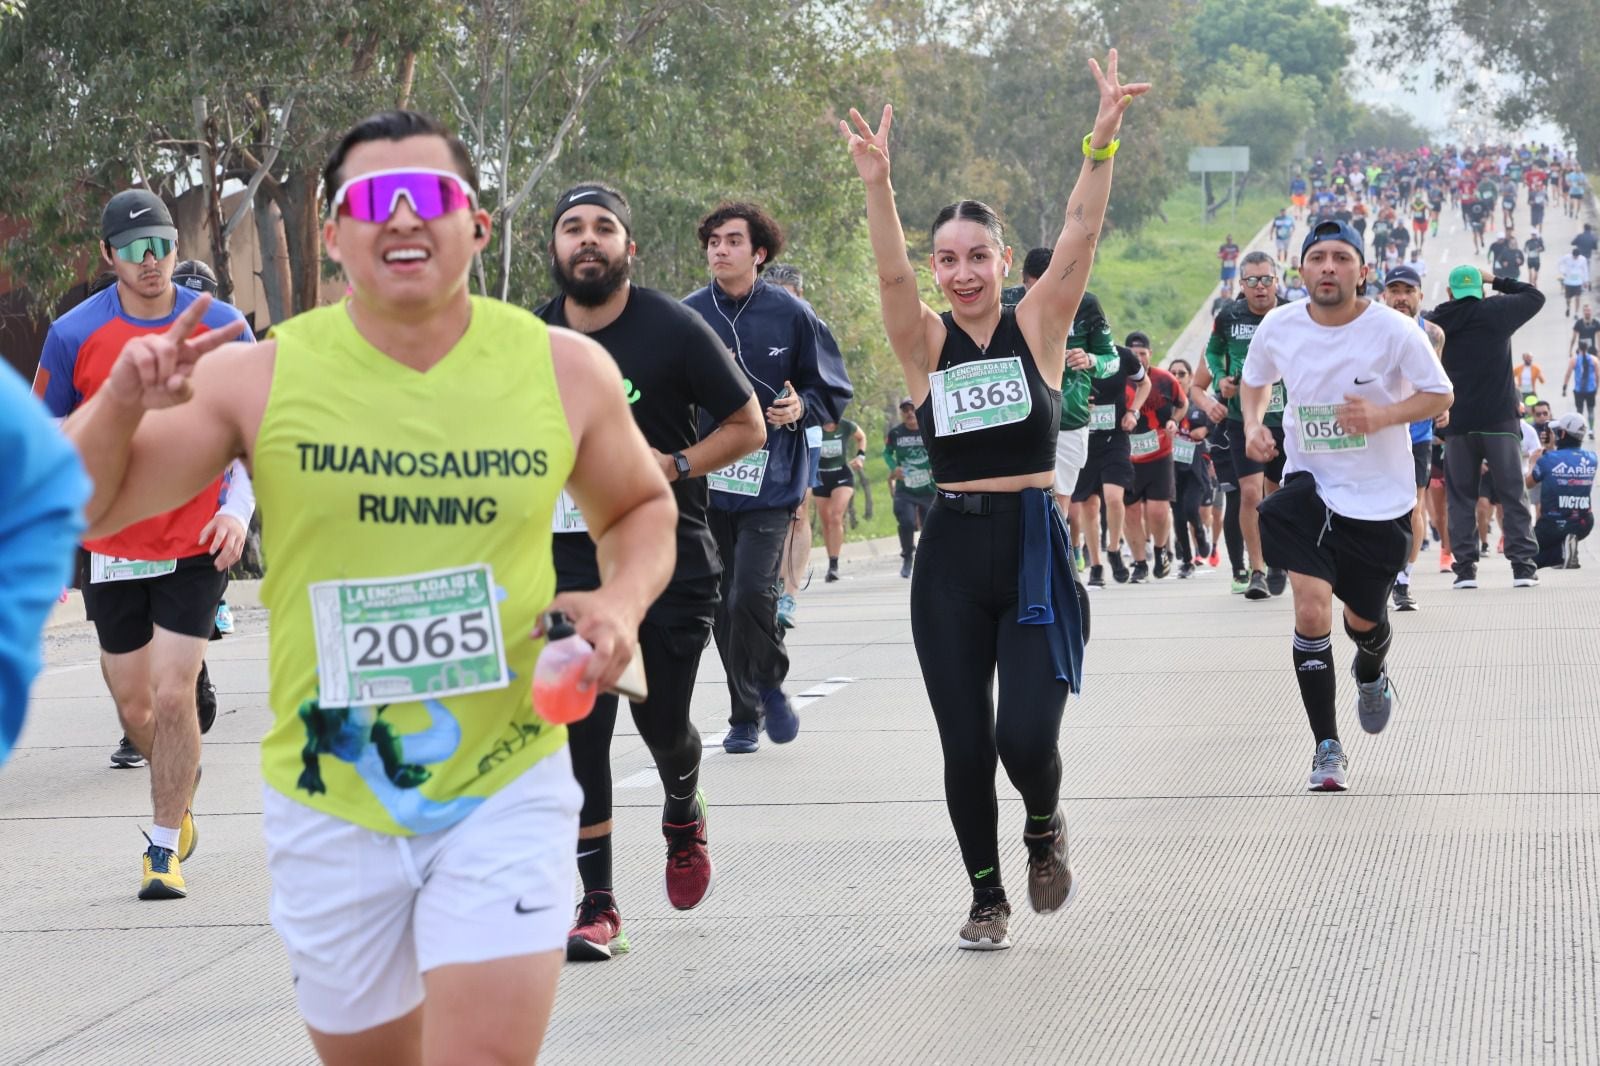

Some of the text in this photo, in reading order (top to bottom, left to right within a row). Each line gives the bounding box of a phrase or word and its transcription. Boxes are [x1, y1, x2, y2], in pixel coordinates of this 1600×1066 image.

[952, 380, 1023, 413] 1363
[1305, 421, 1345, 438] 056
[297, 443, 548, 478] TIJUANOSAURIOS
[711, 464, 760, 482] 364
[358, 494, 498, 525] RUNNING
[1558, 495, 1590, 509] VICTOR
[346, 587, 366, 604] LA
[367, 577, 449, 600] ENCHILADA
[353, 610, 489, 667] 2065
